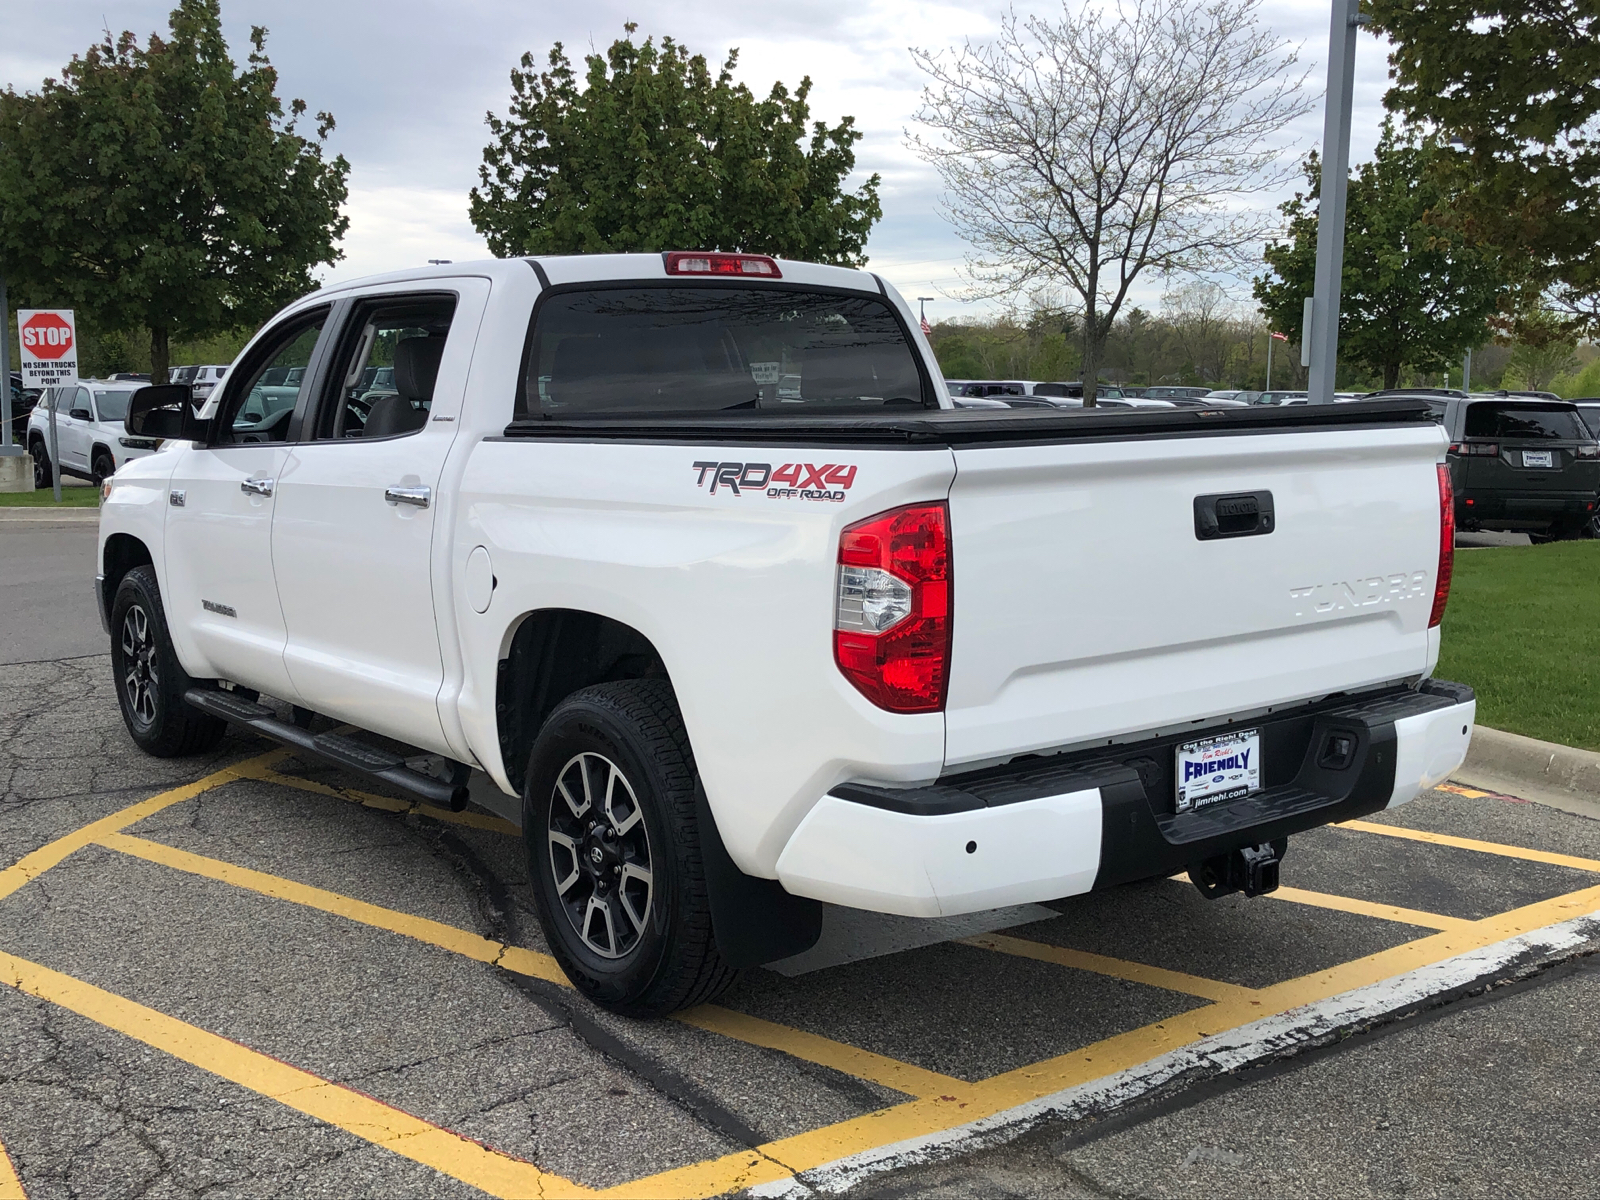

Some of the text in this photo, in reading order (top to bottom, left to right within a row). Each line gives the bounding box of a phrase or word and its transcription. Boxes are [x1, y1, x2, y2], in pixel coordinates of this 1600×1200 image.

[23, 327, 71, 346] STOP
[41, 377, 60, 385] POINT
[692, 461, 772, 497] TRD
[766, 487, 846, 502] OFF ROAD
[1222, 502, 1259, 515] TOYOTA
[1289, 570, 1428, 616] TUNDRA
[1216, 734, 1236, 742] Riehl
[1238, 730, 1257, 738] Deal
[1201, 748, 1233, 762] Jim Riehl's
[1185, 747, 1250, 783] FRIENDLY
[1195, 788, 1247, 808] jimriehl.com
